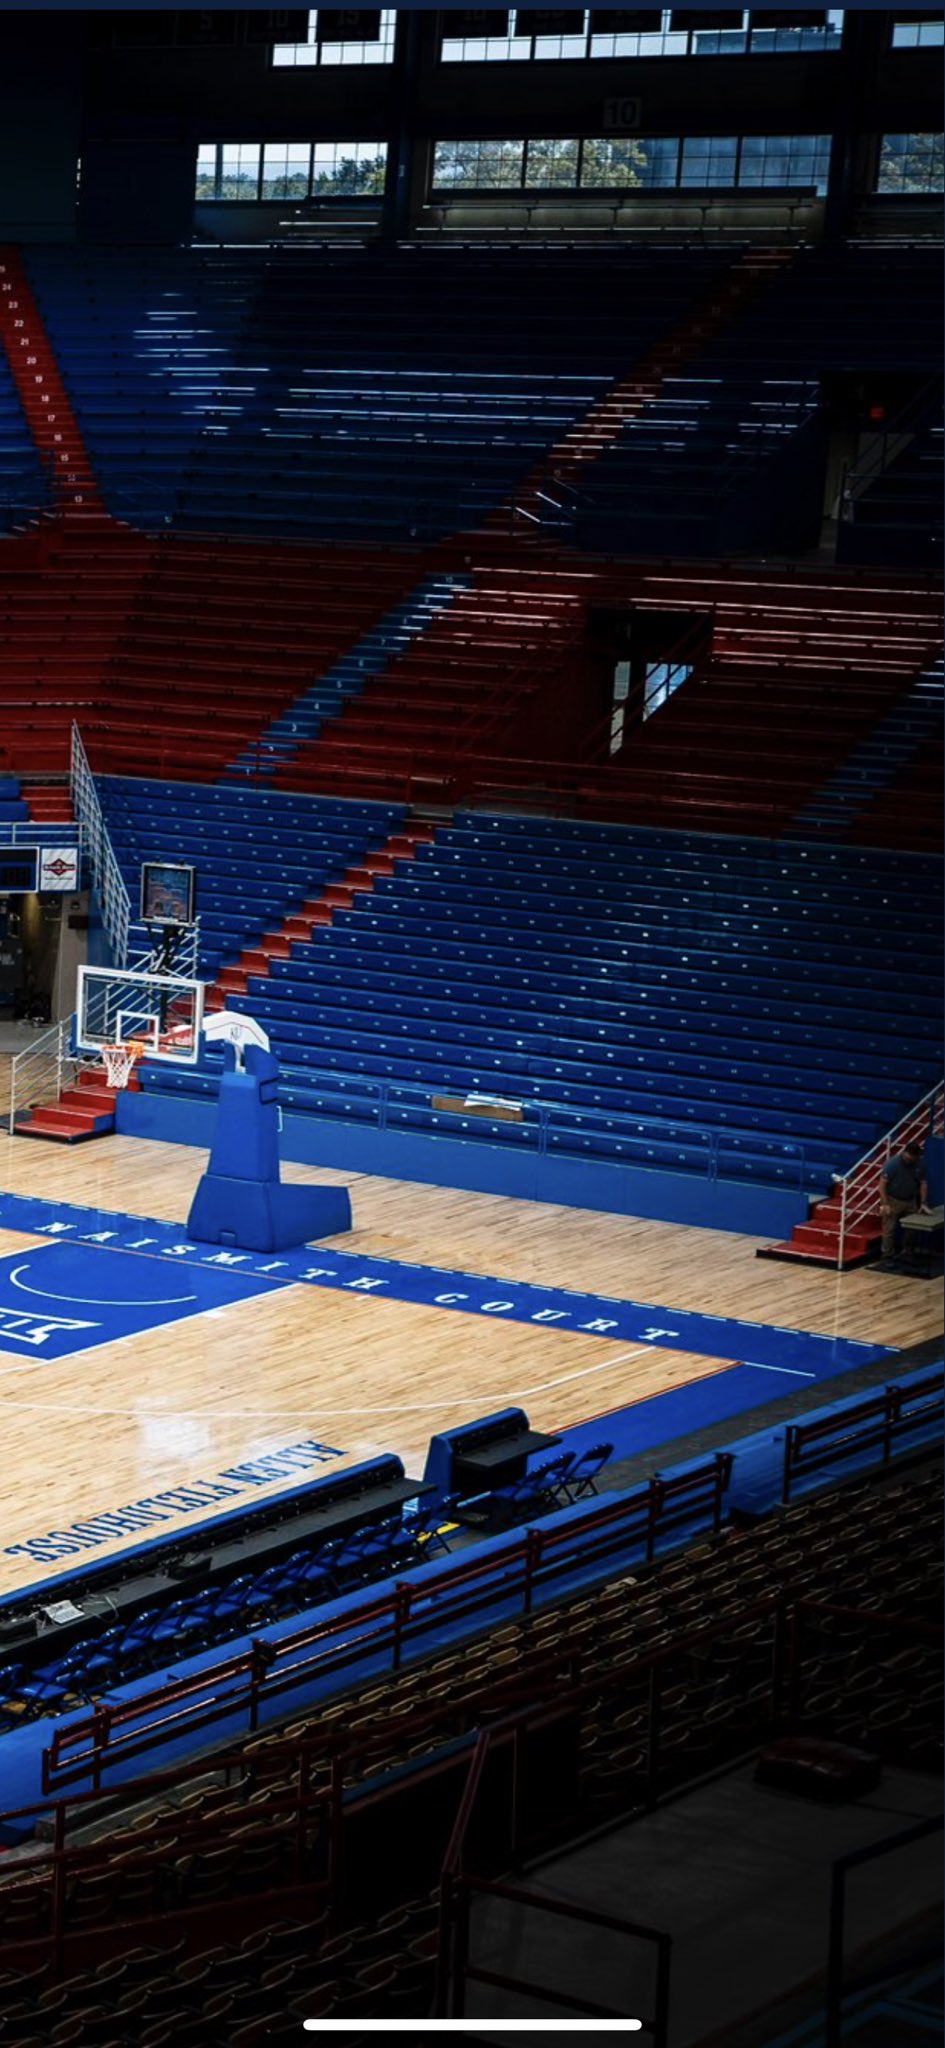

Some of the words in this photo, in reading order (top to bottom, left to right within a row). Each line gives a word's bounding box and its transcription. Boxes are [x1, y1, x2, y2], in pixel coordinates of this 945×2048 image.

[607, 101, 636, 125] 10
[34, 1221, 390, 1290] NAISMITH
[433, 1293, 680, 1341] COURT
[218, 1439, 349, 1486] ALLEN
[4, 1480, 246, 1563] FIELDHOUSE
